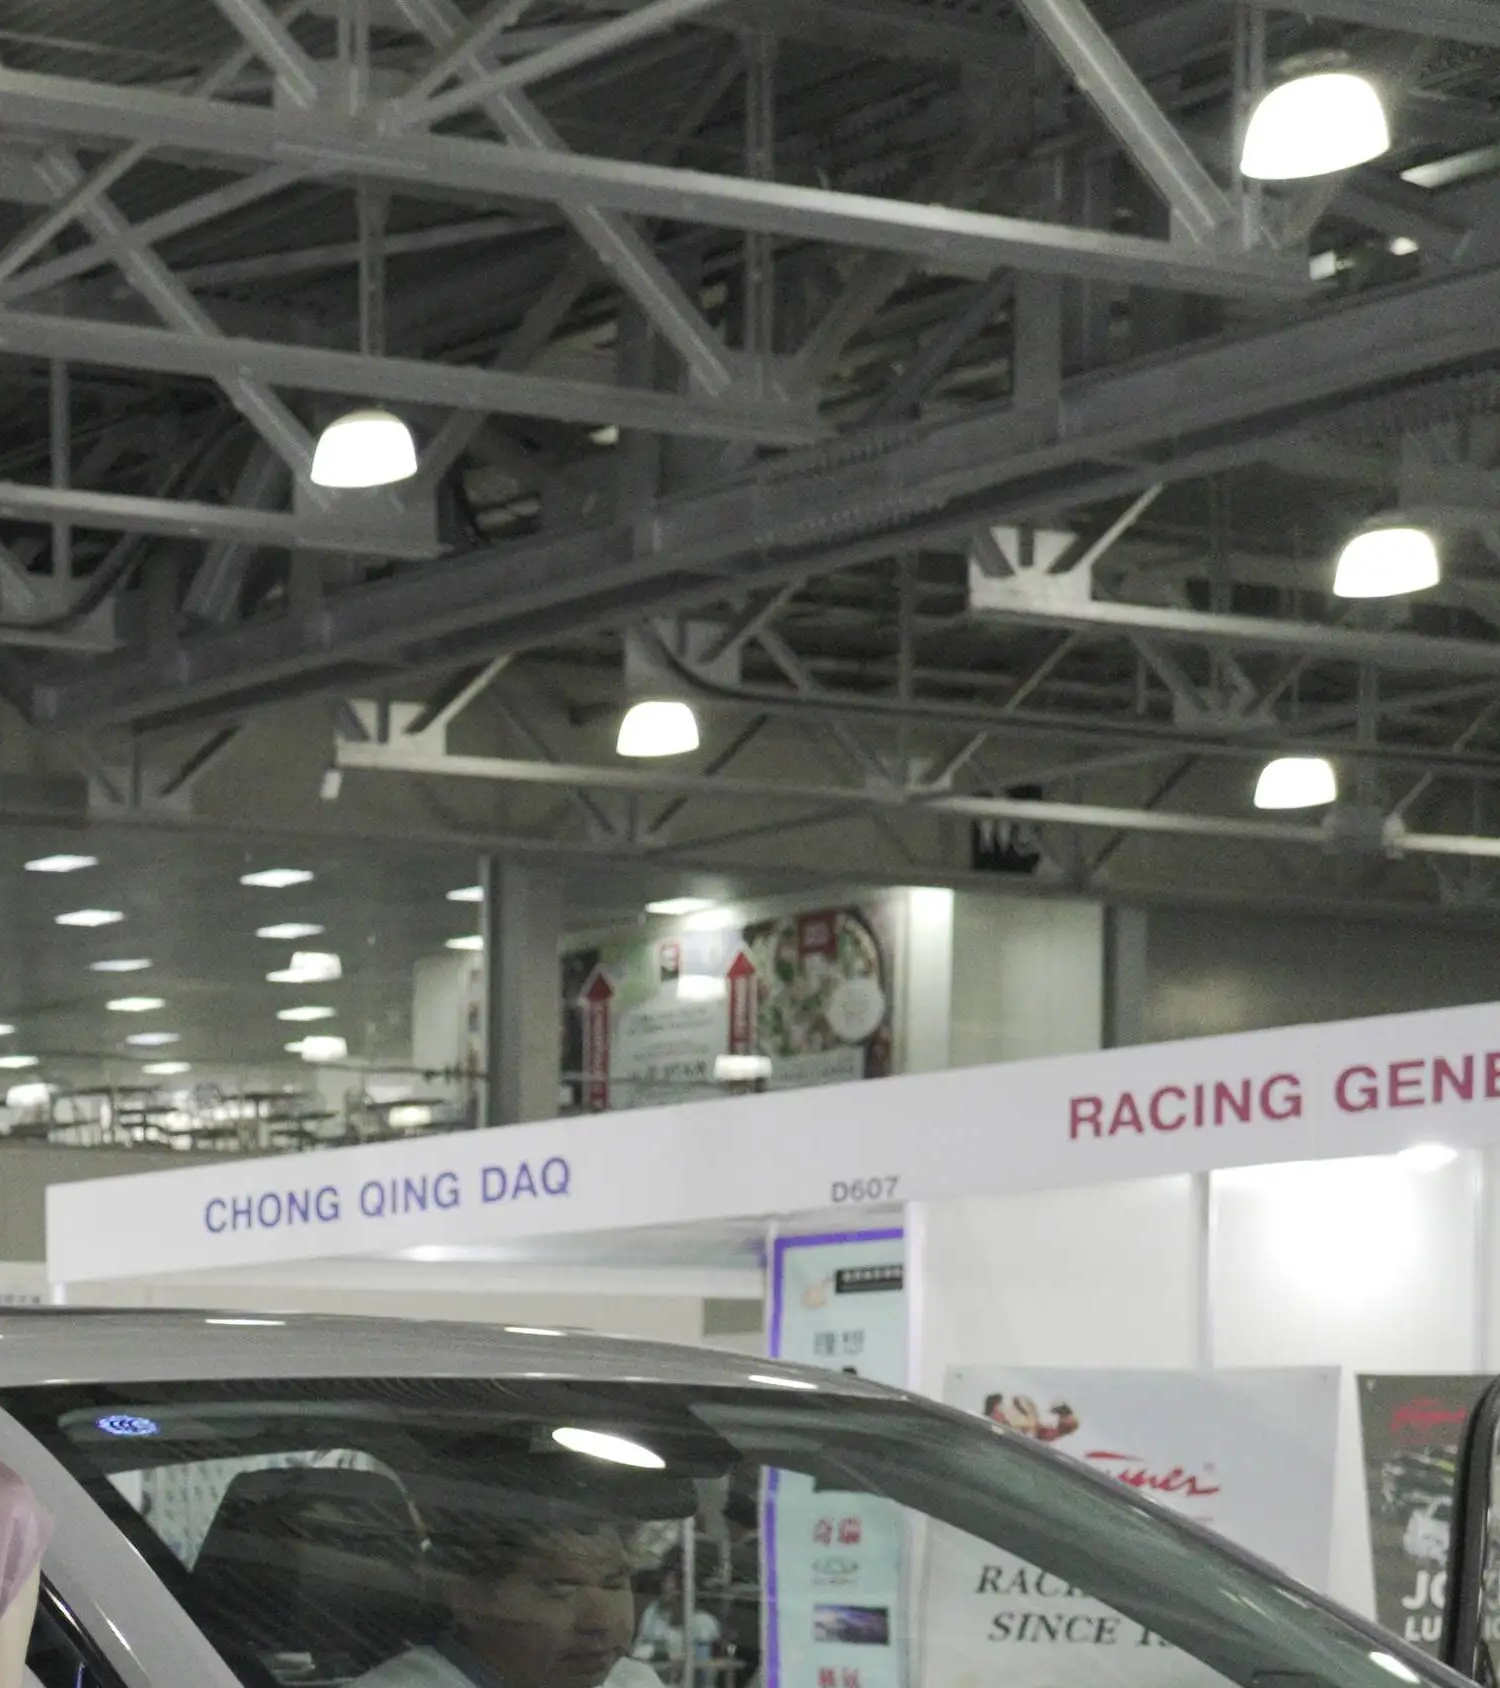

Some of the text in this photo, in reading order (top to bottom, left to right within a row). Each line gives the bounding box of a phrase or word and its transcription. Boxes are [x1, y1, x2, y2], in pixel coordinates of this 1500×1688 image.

[1067, 1072, 1302, 1140] RACING
[204, 1157, 571, 1234] CHONG QING DAQ
[832, 1176, 898, 1202] D607
[987, 1611, 1121, 1646] SINCE
